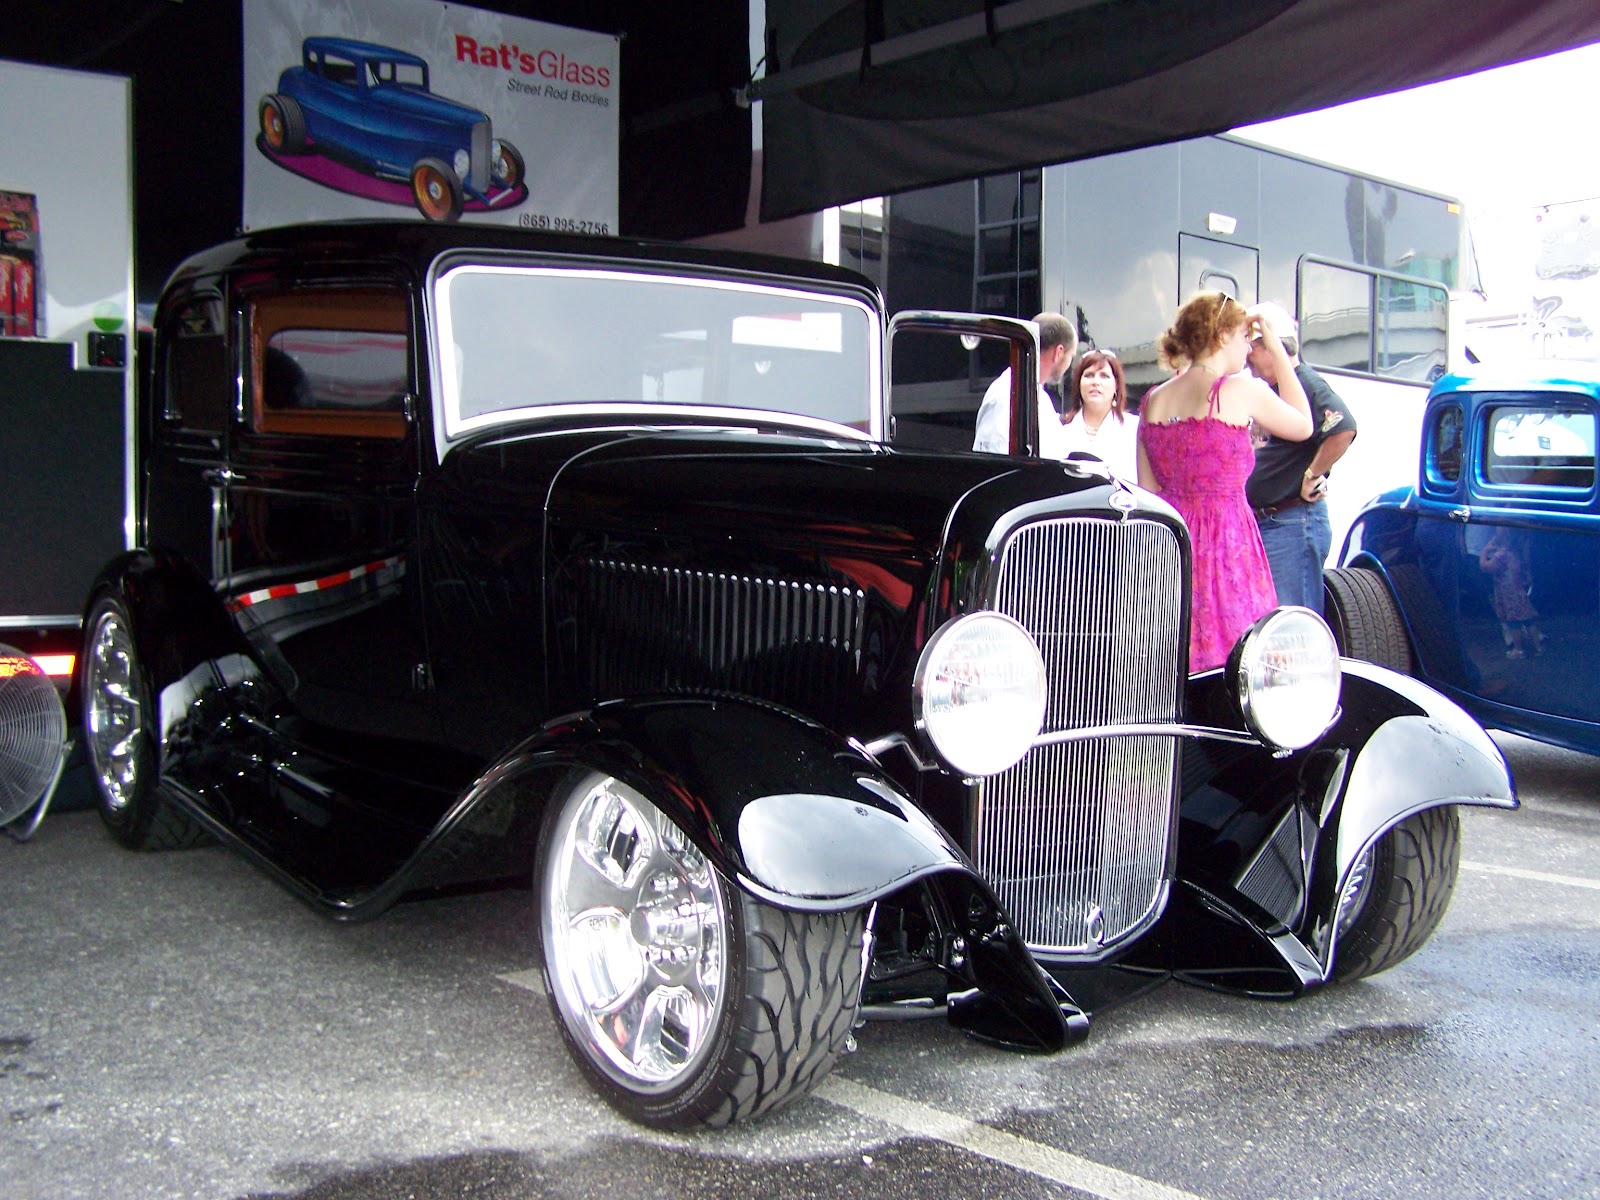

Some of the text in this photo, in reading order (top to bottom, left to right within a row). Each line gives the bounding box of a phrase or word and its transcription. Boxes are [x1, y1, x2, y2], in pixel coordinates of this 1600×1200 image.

[507, 78, 610, 108] Street Rod Bodies
[518, 213, 609, 236] (865) 995-2756
